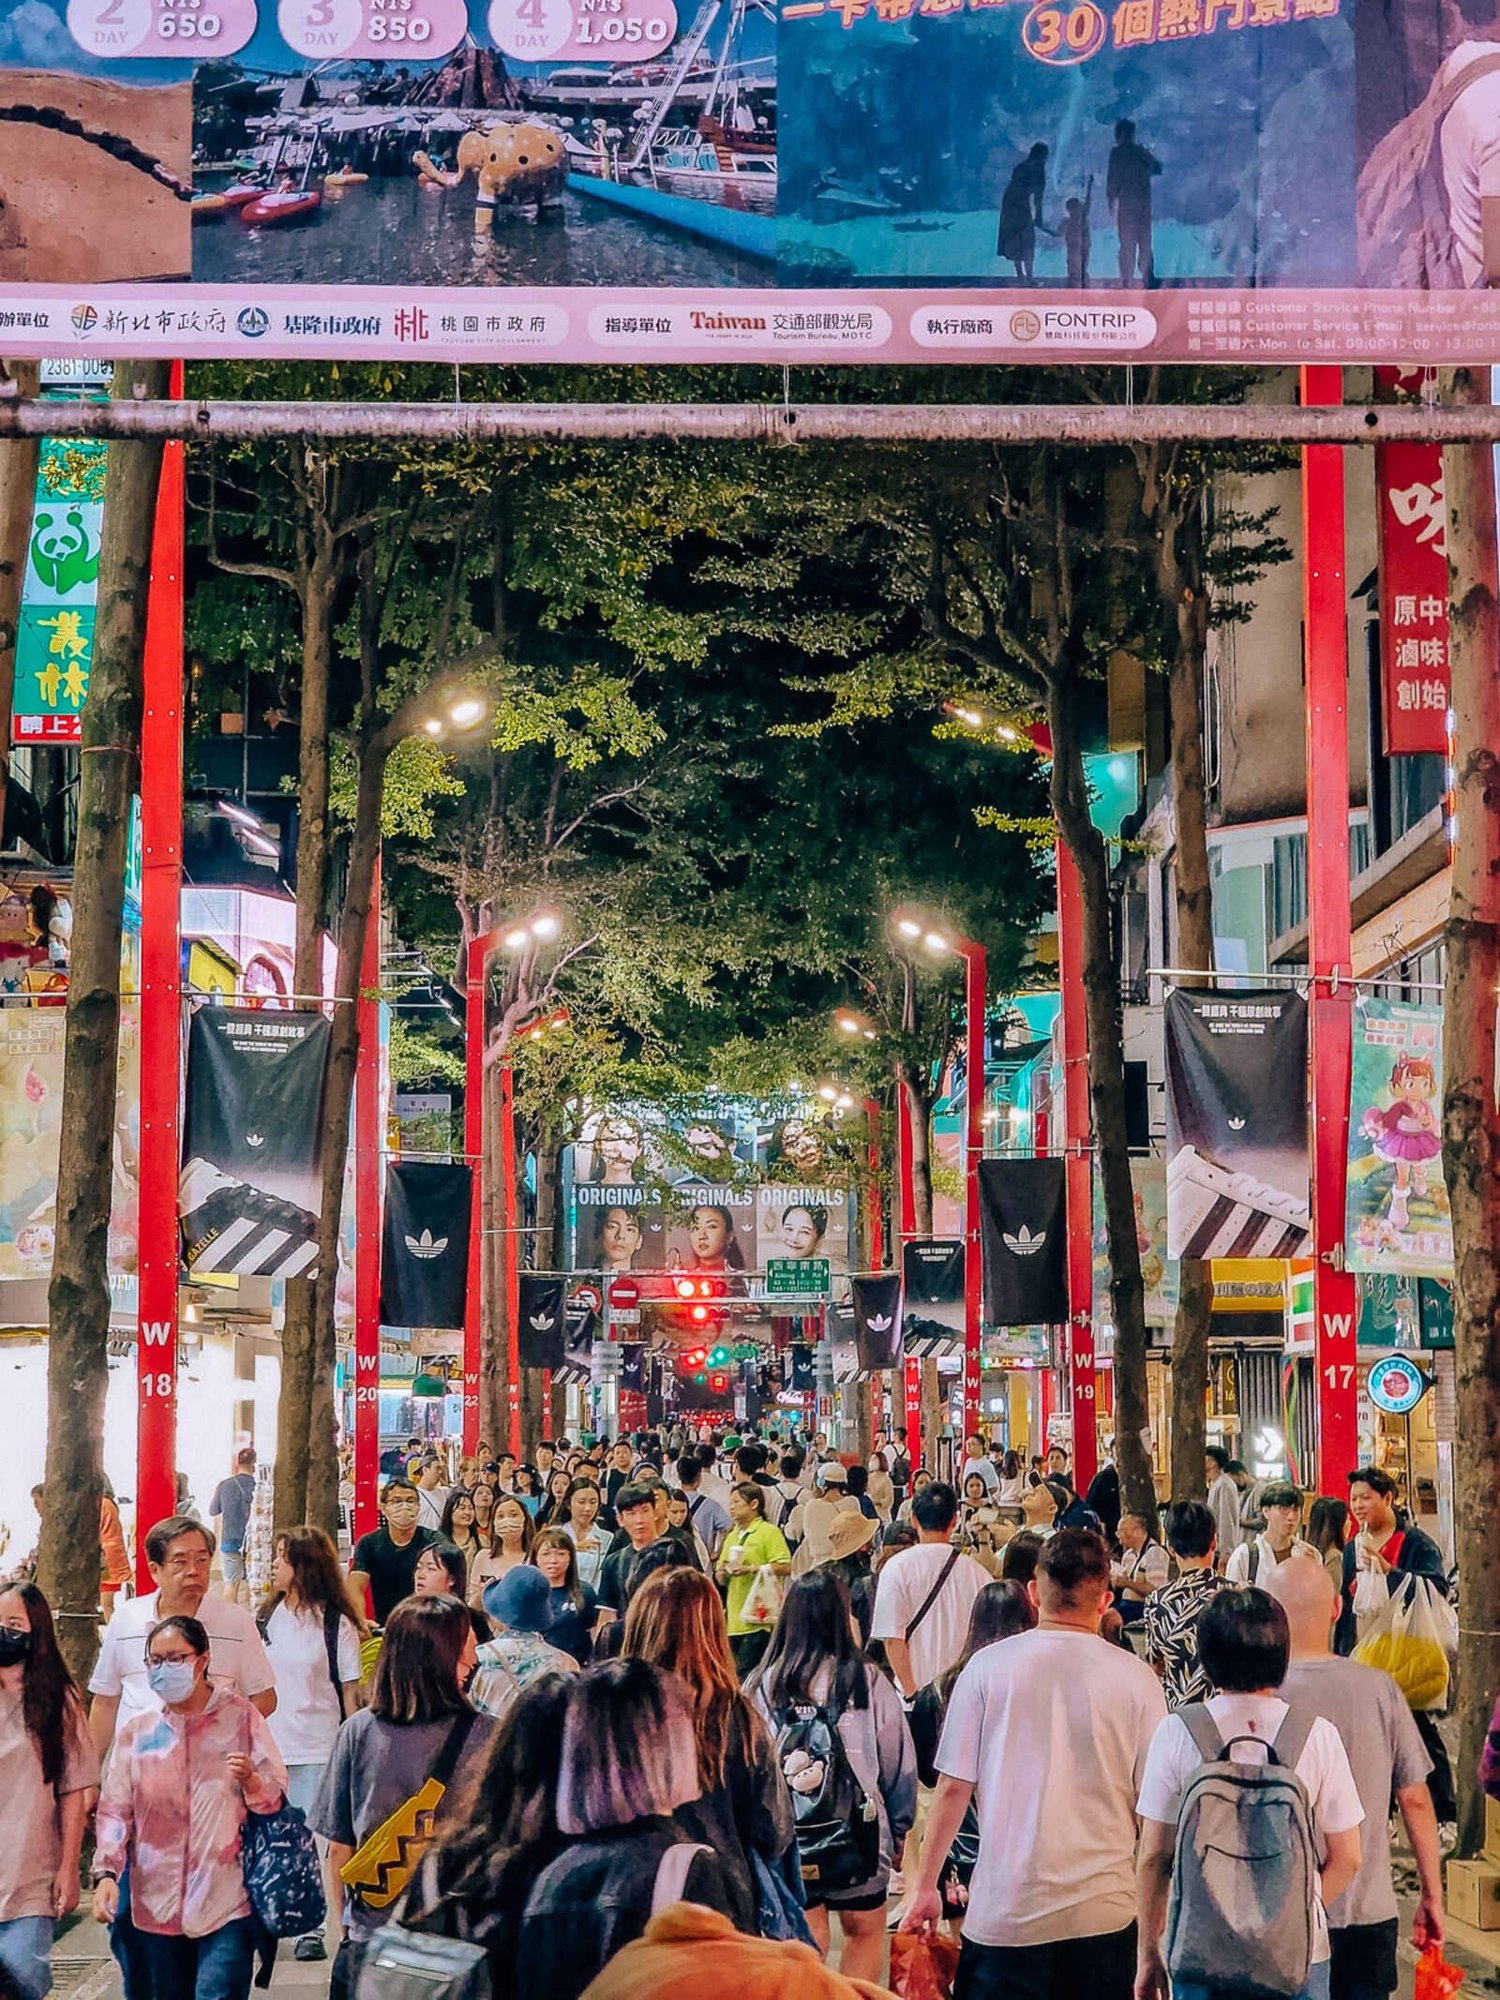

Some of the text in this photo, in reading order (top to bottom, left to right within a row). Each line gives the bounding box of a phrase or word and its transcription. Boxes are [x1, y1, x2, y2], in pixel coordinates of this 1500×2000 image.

[158, 13, 221, 38] 650
[367, 15, 431, 42] 850
[576, 17, 669, 44] 1,050
[1032, 5, 1096, 54] 30
[94, 31, 128, 44] DAY
[305, 31, 340, 45] DAY
[515, 34, 550, 47] DAY
[102, 307, 226, 335] 新北市政府
[284, 314, 381, 336] 基隆市政府
[440, 315, 546, 332] 桃園市政府
[605, 317, 672, 333] 指導單位
[690, 311, 766, 330] Taiwan
[773, 313, 873, 330] 交通部觀光局
[927, 318, 993, 335] 執行廠商
[1044, 312, 1136, 328] FONTRIP
[578, 1187, 662, 1206] ORIGINAS
[761, 1188, 844, 1206] ORIGINALS
[187, 1227, 220, 1261] GAZELLE
[142, 1321, 171, 1346] W
[1323, 1313, 1352, 1338] W
[358, 1355, 377, 1371] W
[1074, 1353, 1092, 1368] W
[142, 1373, 172, 1397] 18
[464, 1373, 478, 1384] W
[967, 1377, 979, 1388] W
[1324, 1364, 1354, 1389] 17
[357, 1387, 377, 1402] 20
[464, 1395, 479, 1406] 22
[1075, 1384, 1094, 1400] 19
[966, 1398, 979, 1409] 21
